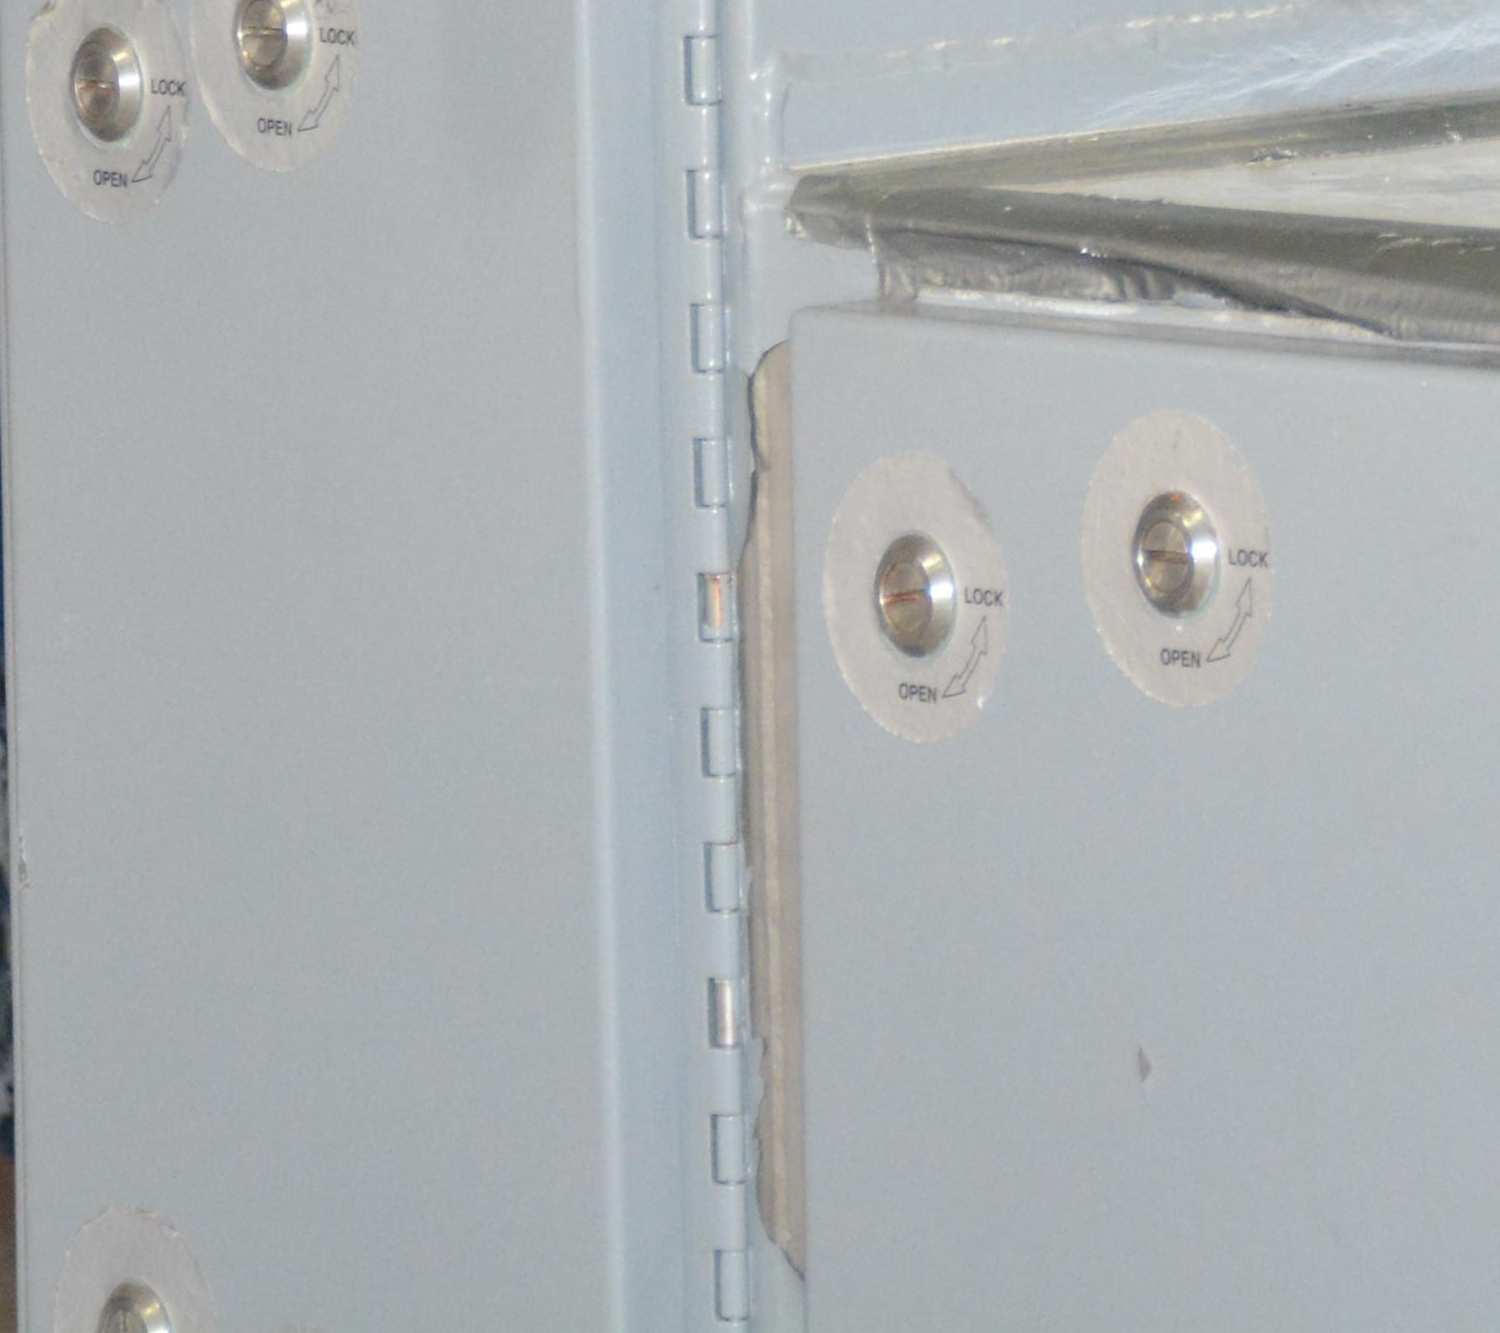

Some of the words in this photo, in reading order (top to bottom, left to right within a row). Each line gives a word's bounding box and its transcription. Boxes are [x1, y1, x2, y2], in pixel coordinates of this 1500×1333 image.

[319, 27, 356, 47] LOCK
[150, 79, 186, 98] LOCK
[256, 116, 293, 136] OPEN
[92, 169, 129, 189] OPEN
[1227, 548, 1269, 569] LOCK
[963, 586, 1004, 608] LOCK
[1159, 648, 1201, 669] OPEN
[898, 682, 938, 704] OPEN
